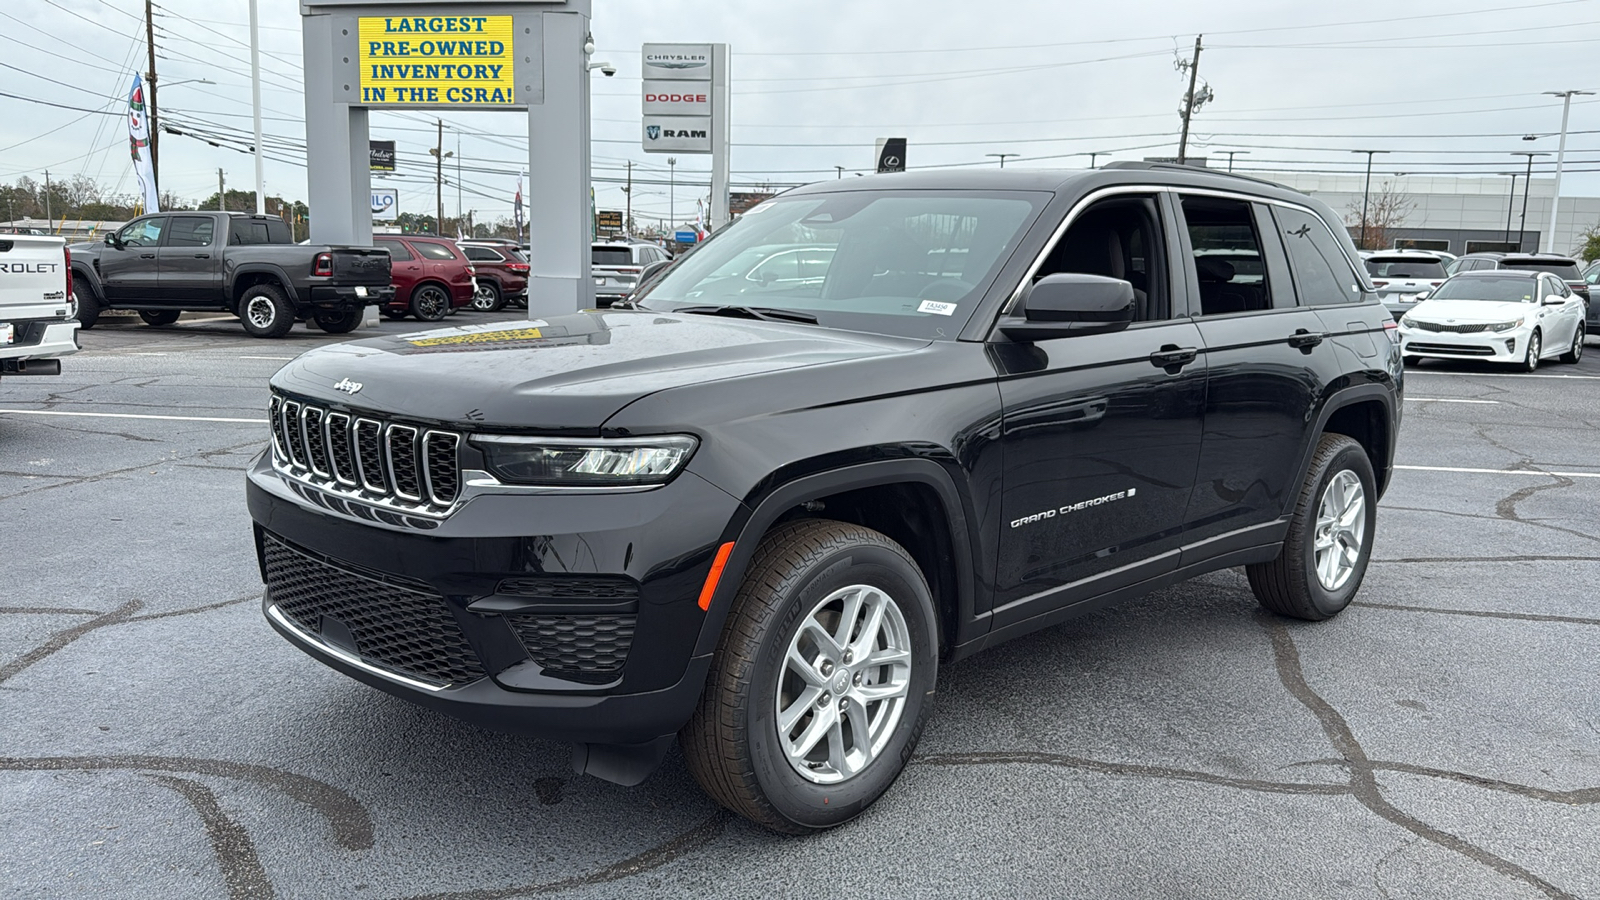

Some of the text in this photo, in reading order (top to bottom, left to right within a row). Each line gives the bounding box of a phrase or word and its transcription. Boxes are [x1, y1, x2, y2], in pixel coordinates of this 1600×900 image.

[385, 18, 487, 32] LARGEST
[369, 41, 505, 56] PRE-OWNED
[371, 64, 503, 79] INVENTORY
[363, 87, 512, 103] IN THE CSRA!
[645, 94, 707, 102] DODGE
[663, 130, 706, 138] RAM
[333, 377, 363, 394] Jeep
[1010, 491, 1125, 528] GRAND CHEROKEE
[766, 600, 802, 672] ICHELIN
